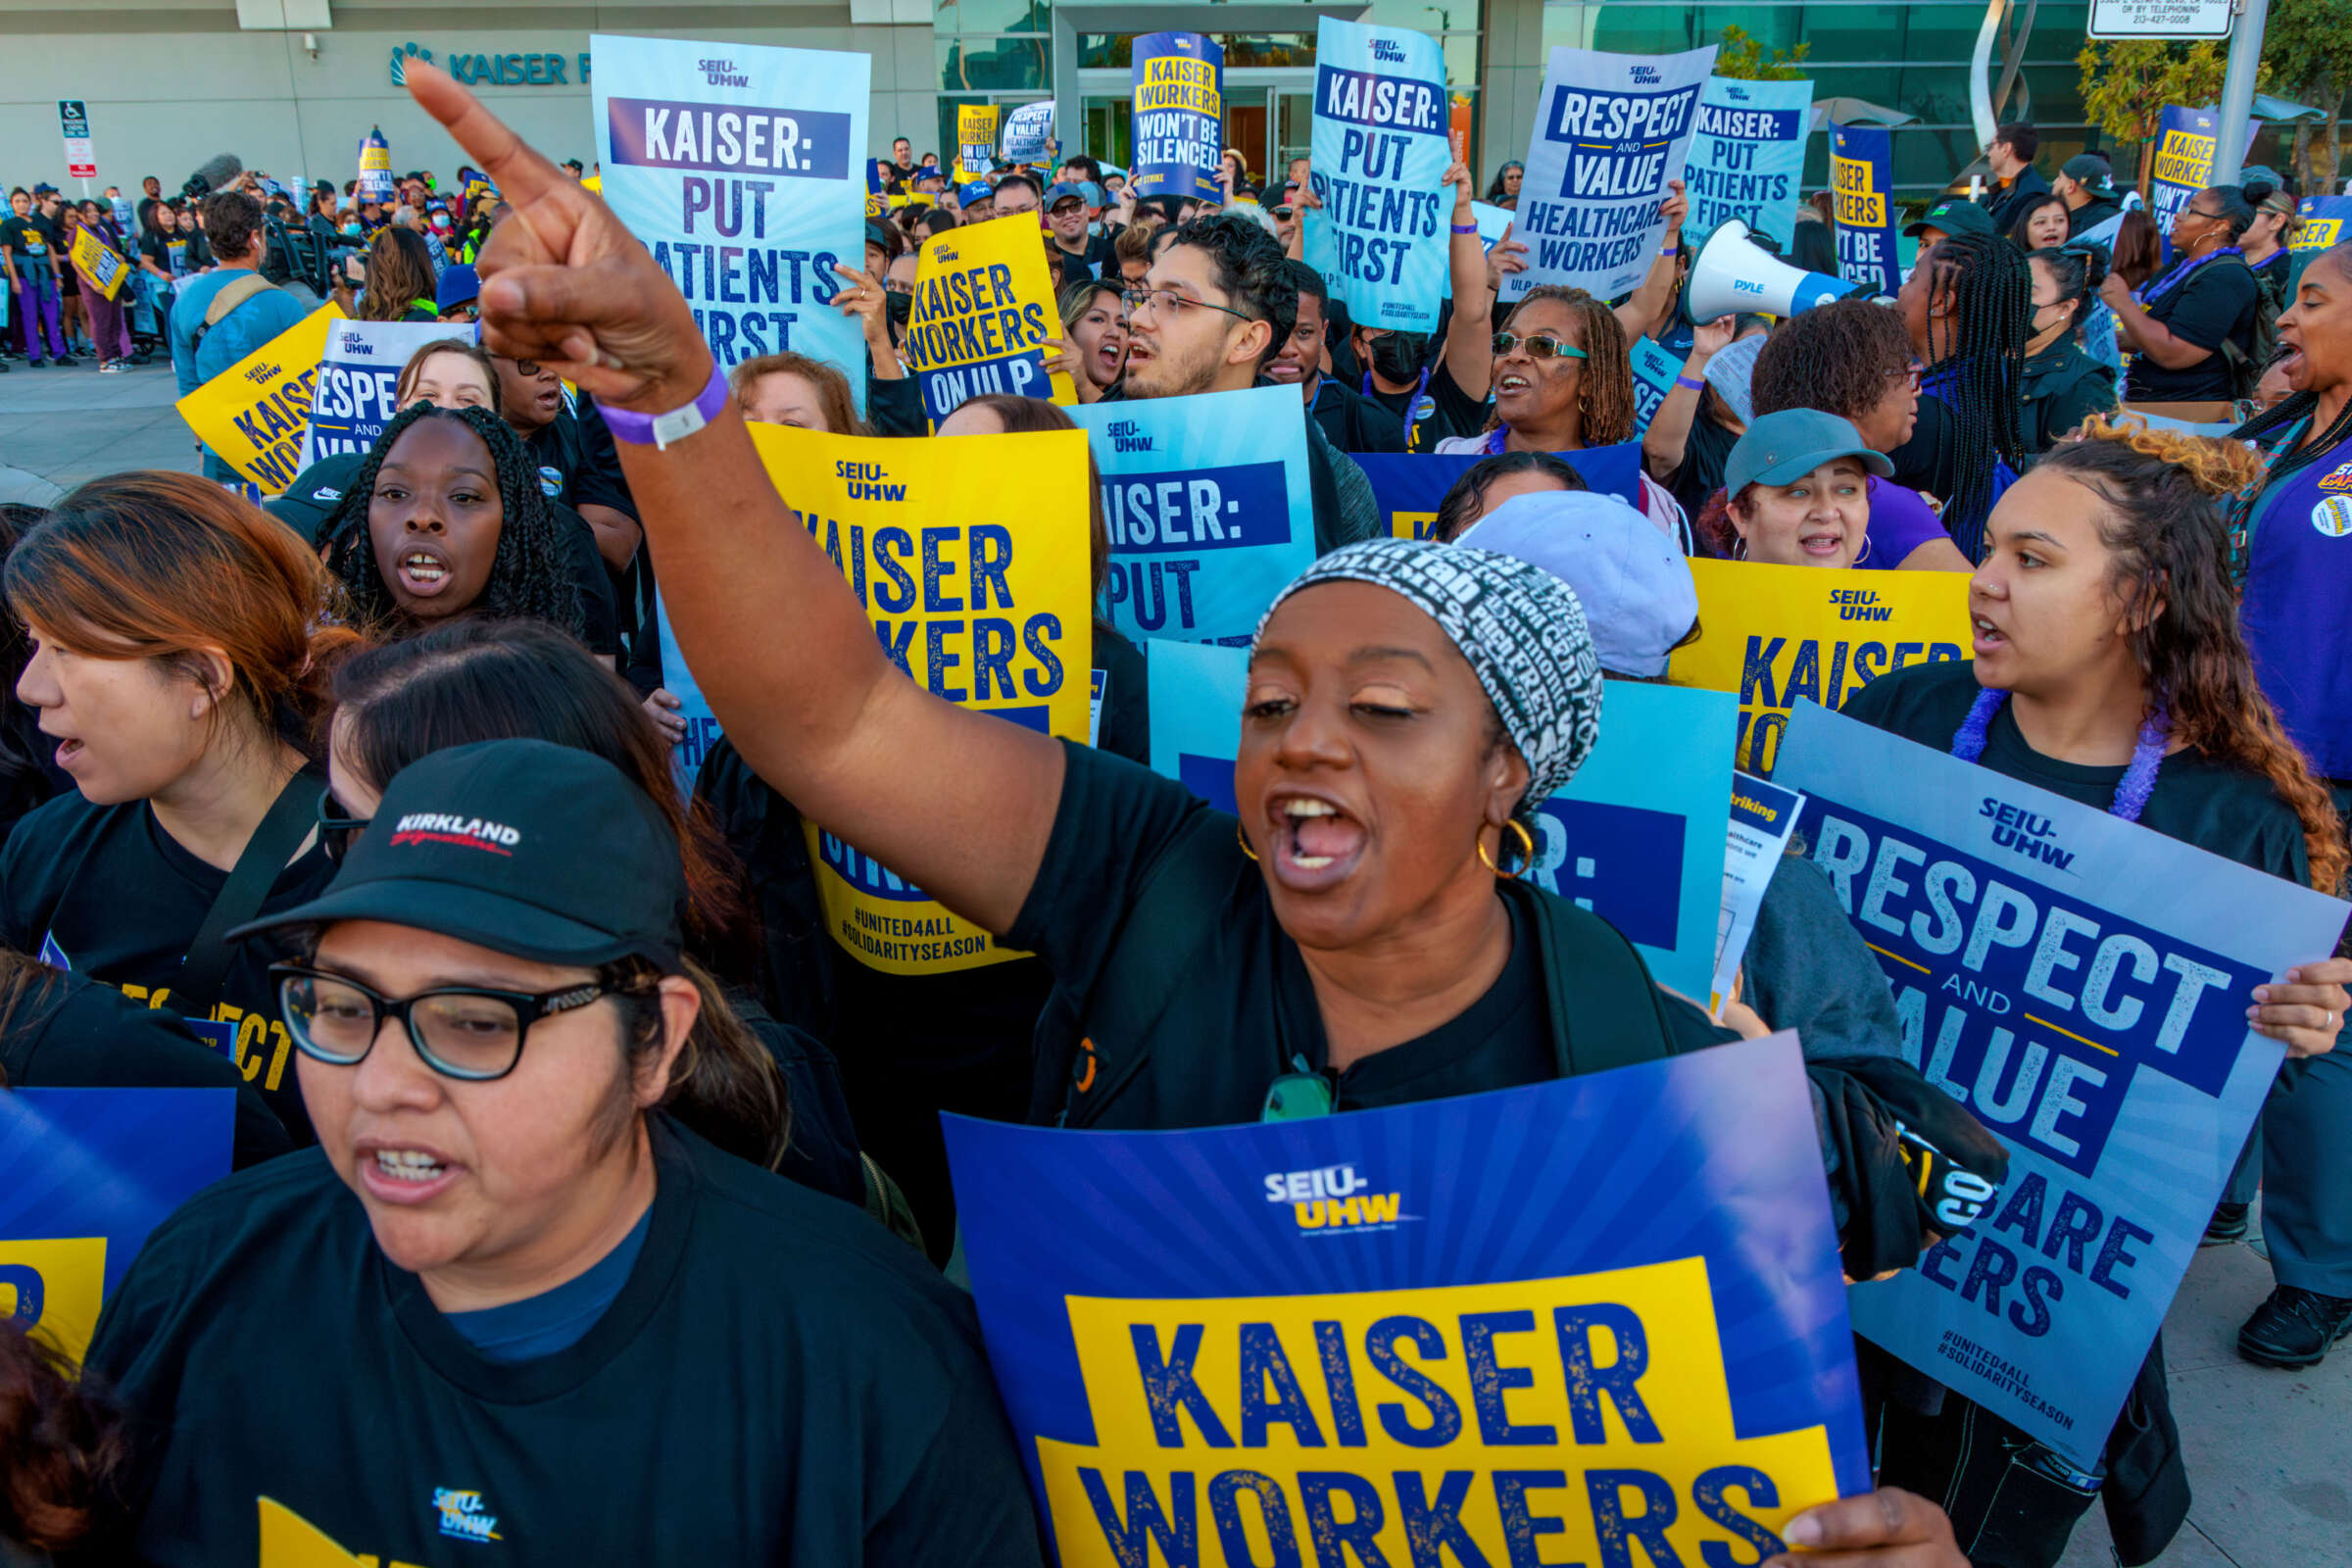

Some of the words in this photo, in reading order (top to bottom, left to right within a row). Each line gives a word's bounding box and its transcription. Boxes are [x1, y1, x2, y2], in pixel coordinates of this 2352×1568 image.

[2136, 5, 2146, 14] BY
[2150, 5, 2201, 14] TELEPHONING
[1368, 38, 1399, 51] SEIU-
[1374, 52, 1407, 63] UHW
[449, 53, 568, 85] KAISER
[698, 59, 738, 73] SEIU-
[708, 74, 750, 87] UHW
[1151, 60, 1211, 87] KAISER
[1629, 66, 1657, 75] SEIU-
[1634, 75, 1663, 84] UHW
[1140, 84, 1218, 115] WORKERS
[1327, 73, 1439, 129] KAISER:
[1559, 89, 1694, 140] RESPECT
[959, 130, 994, 143] WORKER
[962, 118, 993, 130] KAISER
[1015, 123, 1042, 135] VALUE
[1138, 113, 1199, 140] WON'T
[1200, 118, 1218, 147] BE
[1698, 106, 1781, 139] KAISER:
[645, 108, 812, 171] KAISER:
[1005, 137, 1046, 147] HEALTHCAR
[1137, 138, 1218, 172] SILENCED
[1340, 127, 1413, 180] PUT
[1616, 142, 1641, 153] AND
[2167, 134, 2215, 164] KAISE
[1711, 140, 1759, 172] PUT
[2156, 155, 2212, 184] WORKER
[1573, 152, 1665, 196] VALUE
[1684, 164, 1788, 202] PATIENTS
[1834, 162, 1865, 193] ISER
[683, 176, 775, 239] PUT
[1310, 171, 1441, 238] PATIENTS
[1835, 190, 1879, 223] KERS
[2154, 183, 2192, 215] ON'T
[1525, 197, 1669, 238] HEALTHCARE
[2296, 221, 2330, 243] SER
[933, 245, 951, 256] SEIU-
[938, 252, 958, 264] UHW
[1332, 225, 1412, 285] FIRST
[1539, 232, 1646, 272] WORKERS
[1854, 232, 1884, 263] BE
[639, 240, 841, 306] ATIENTS
[1511, 278, 1532, 292] ULP
[1734, 278, 1764, 295] PYLE
[914, 263, 1017, 324] KAISER
[338, 330, 364, 345] SEIU-
[344, 342, 373, 356] UHW
[693, 309, 798, 366] RST
[904, 302, 1049, 368] WORKERS
[243, 362, 270, 382] SEIU-
[253, 364, 284, 386] UHW
[232, 361, 324, 451] KAISE
[311, 366, 396, 421] ESPE
[931, 370, 968, 416] ON
[354, 423, 382, 437] AND
[1107, 420, 1140, 439] SEIU-
[1113, 436, 1153, 454] UHW
[836, 461, 889, 482] SEIU-
[848, 481, 907, 503] UHW
[1102, 478, 1243, 547] ISER:
[792, 510, 1015, 614] ISER
[1109, 560, 1200, 632] PUT
[1829, 589, 1881, 605] SEIU-
[1839, 606, 1893, 621] UHW
[875, 612, 1064, 704] KERS
[1740, 635, 1963, 711] KAIS
[1508, 649, 1556, 727] FRET
[1731, 792, 1778, 822] triking
[1979, 796, 2059, 839] SEIU-
[396, 813, 520, 846] KIRKLAND
[1728, 831, 1763, 849] althcare
[1991, 821, 2076, 871] UHW
[855, 906, 956, 938] #UNITED4ALL
[1812, 813, 2233, 1055] RESPECT
[842, 919, 987, 962] #SOLIDARITYSEASON
[1940, 972, 2012, 1015] AND
[1889, 976, 2109, 1159] ALUE
[1264, 1166, 1368, 1202] SEIU-
[1294, 1193, 1400, 1229] UHW
[1129, 1300, 1664, 1449] KAISER
[1942, 1329, 2032, 1389] #UNITED4ALL
[1936, 1342, 2075, 1433] #SOLIDARITYSEASON
[432, 1486, 485, 1513] SEIU-
[1076, 1464, 1791, 1568] WORKERS
